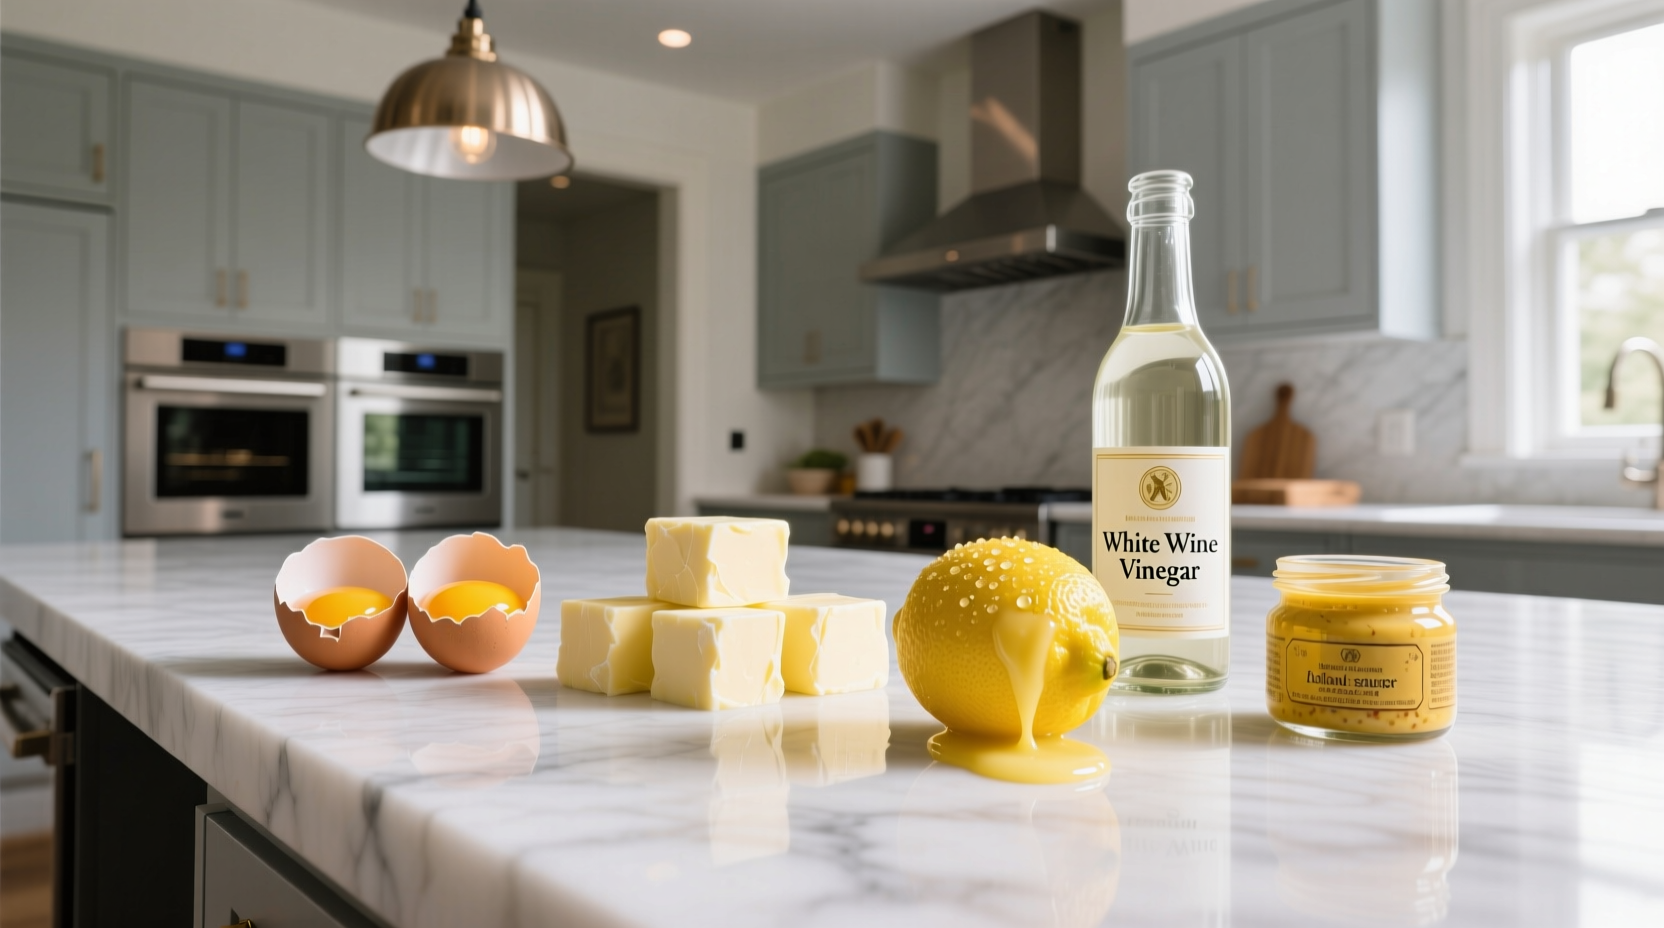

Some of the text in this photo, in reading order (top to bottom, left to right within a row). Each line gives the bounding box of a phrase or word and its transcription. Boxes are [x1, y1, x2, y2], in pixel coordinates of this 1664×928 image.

[1102, 530, 1218, 554] White Wine
[1119, 558, 1200, 587] Vinegar
